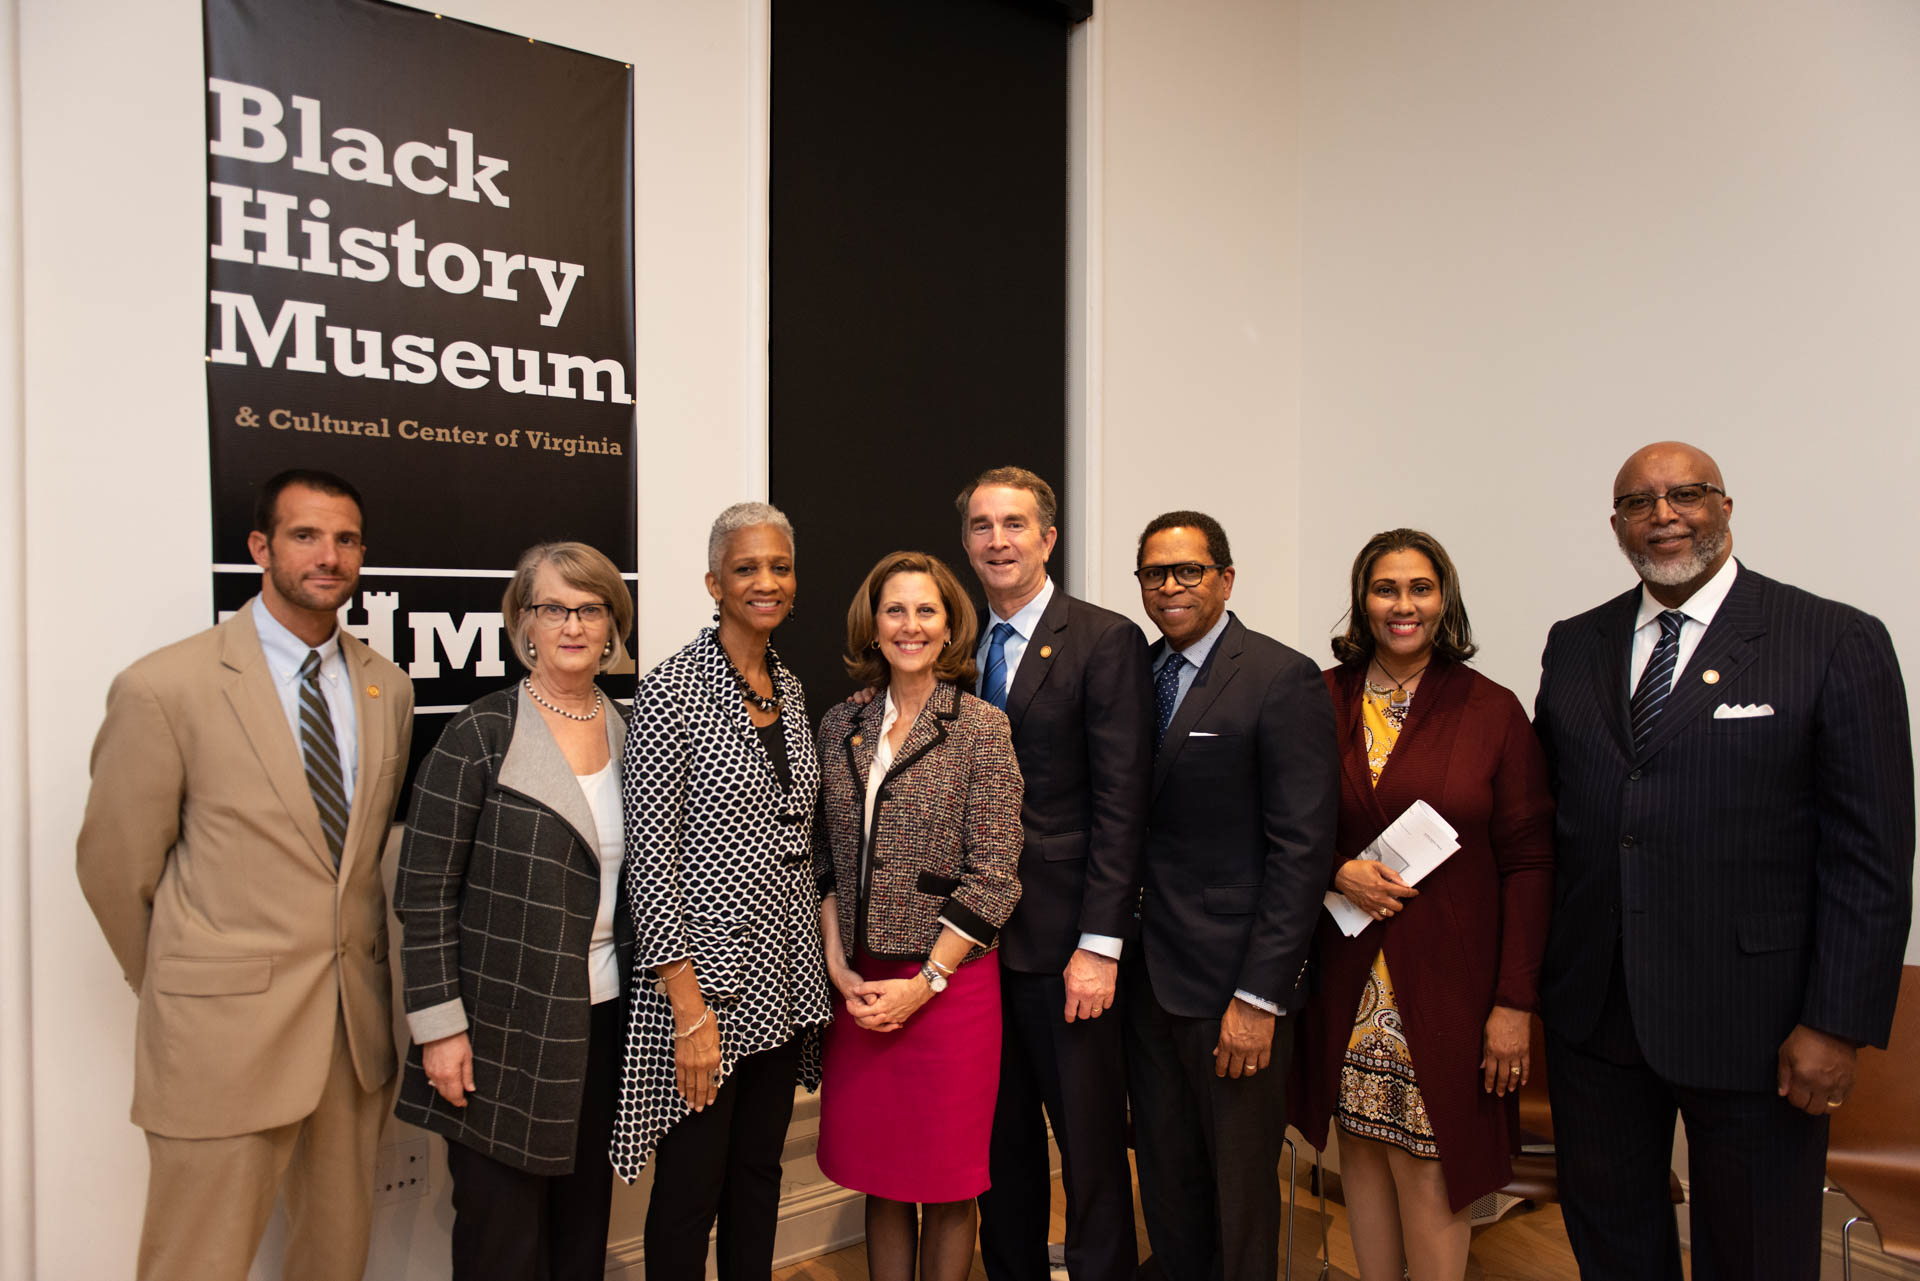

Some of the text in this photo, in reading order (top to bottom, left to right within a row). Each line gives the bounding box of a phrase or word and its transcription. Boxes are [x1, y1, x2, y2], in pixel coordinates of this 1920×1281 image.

[208, 77, 510, 209] Black
[209, 180, 586, 329] History
[209, 289, 634, 406] Museum
[235, 406, 623, 457] & Cultural Center of Virginia
